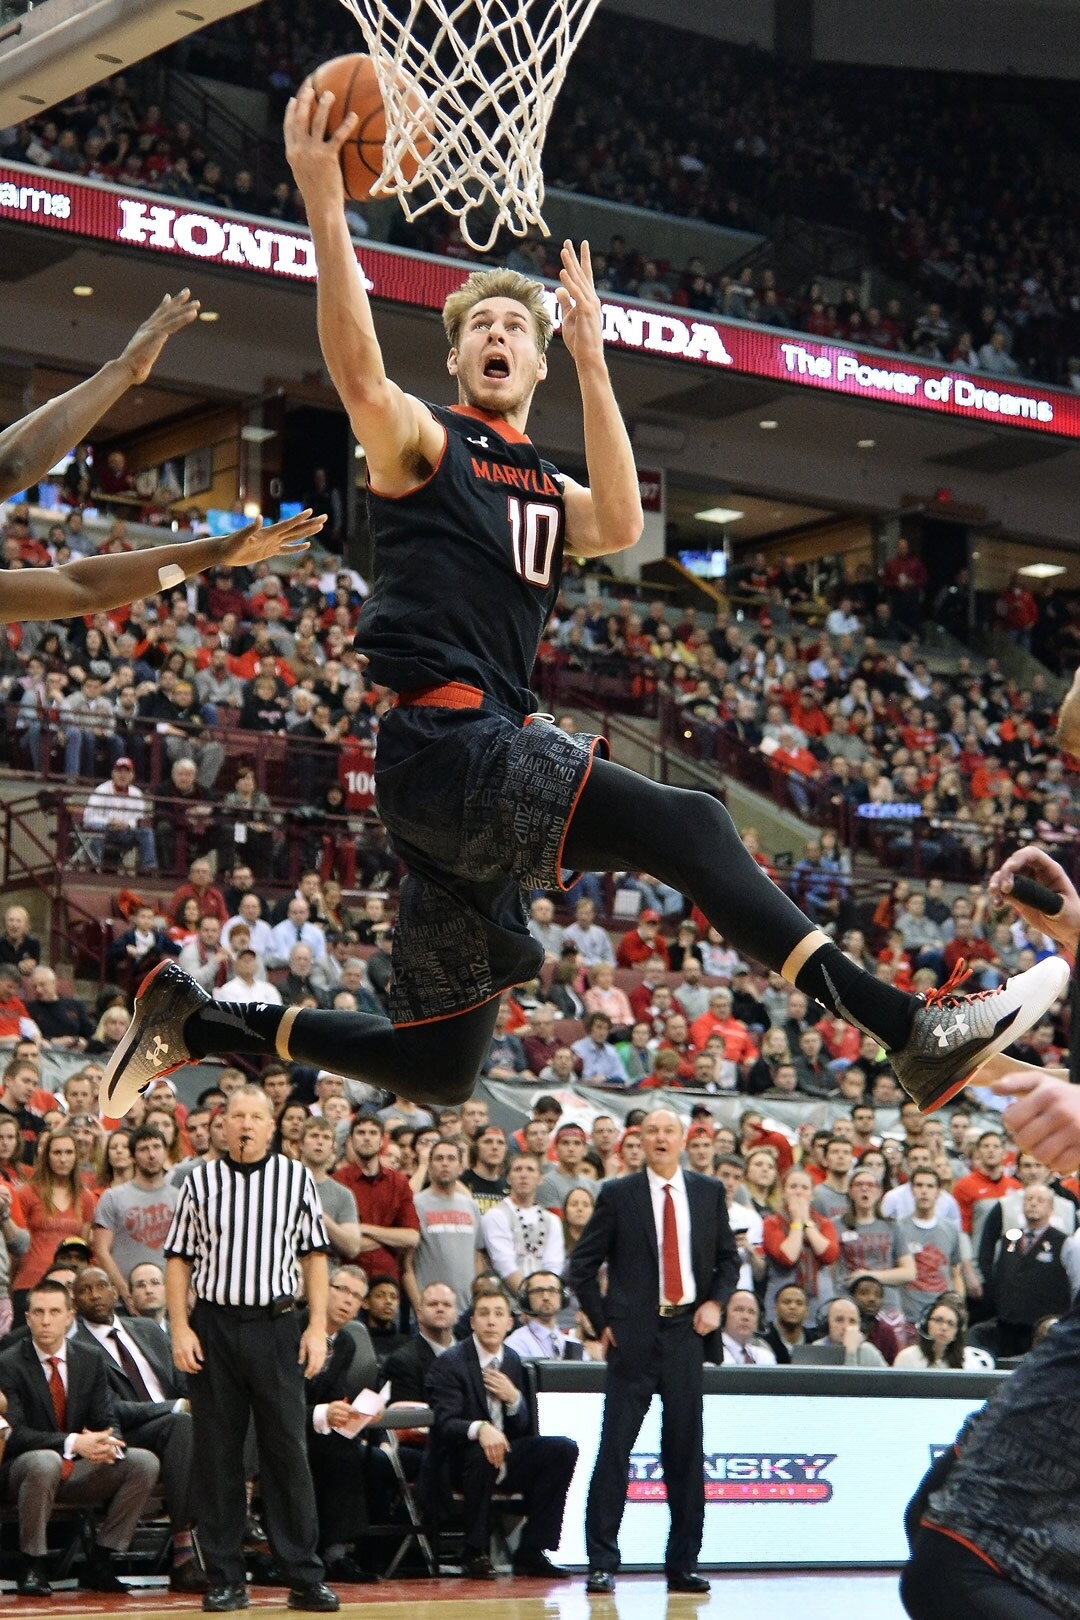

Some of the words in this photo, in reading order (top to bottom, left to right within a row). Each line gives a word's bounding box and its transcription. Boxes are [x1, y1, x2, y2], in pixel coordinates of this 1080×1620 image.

[117, 199, 374, 291] HOND
[780, 343, 832, 379] The
[837, 355, 922, 396] Power
[923, 376, 953, 402] of
[954, 379, 1054, 423] Dreams
[507, 495, 561, 589] 10
[515, 753, 576, 783] MARYLAND
